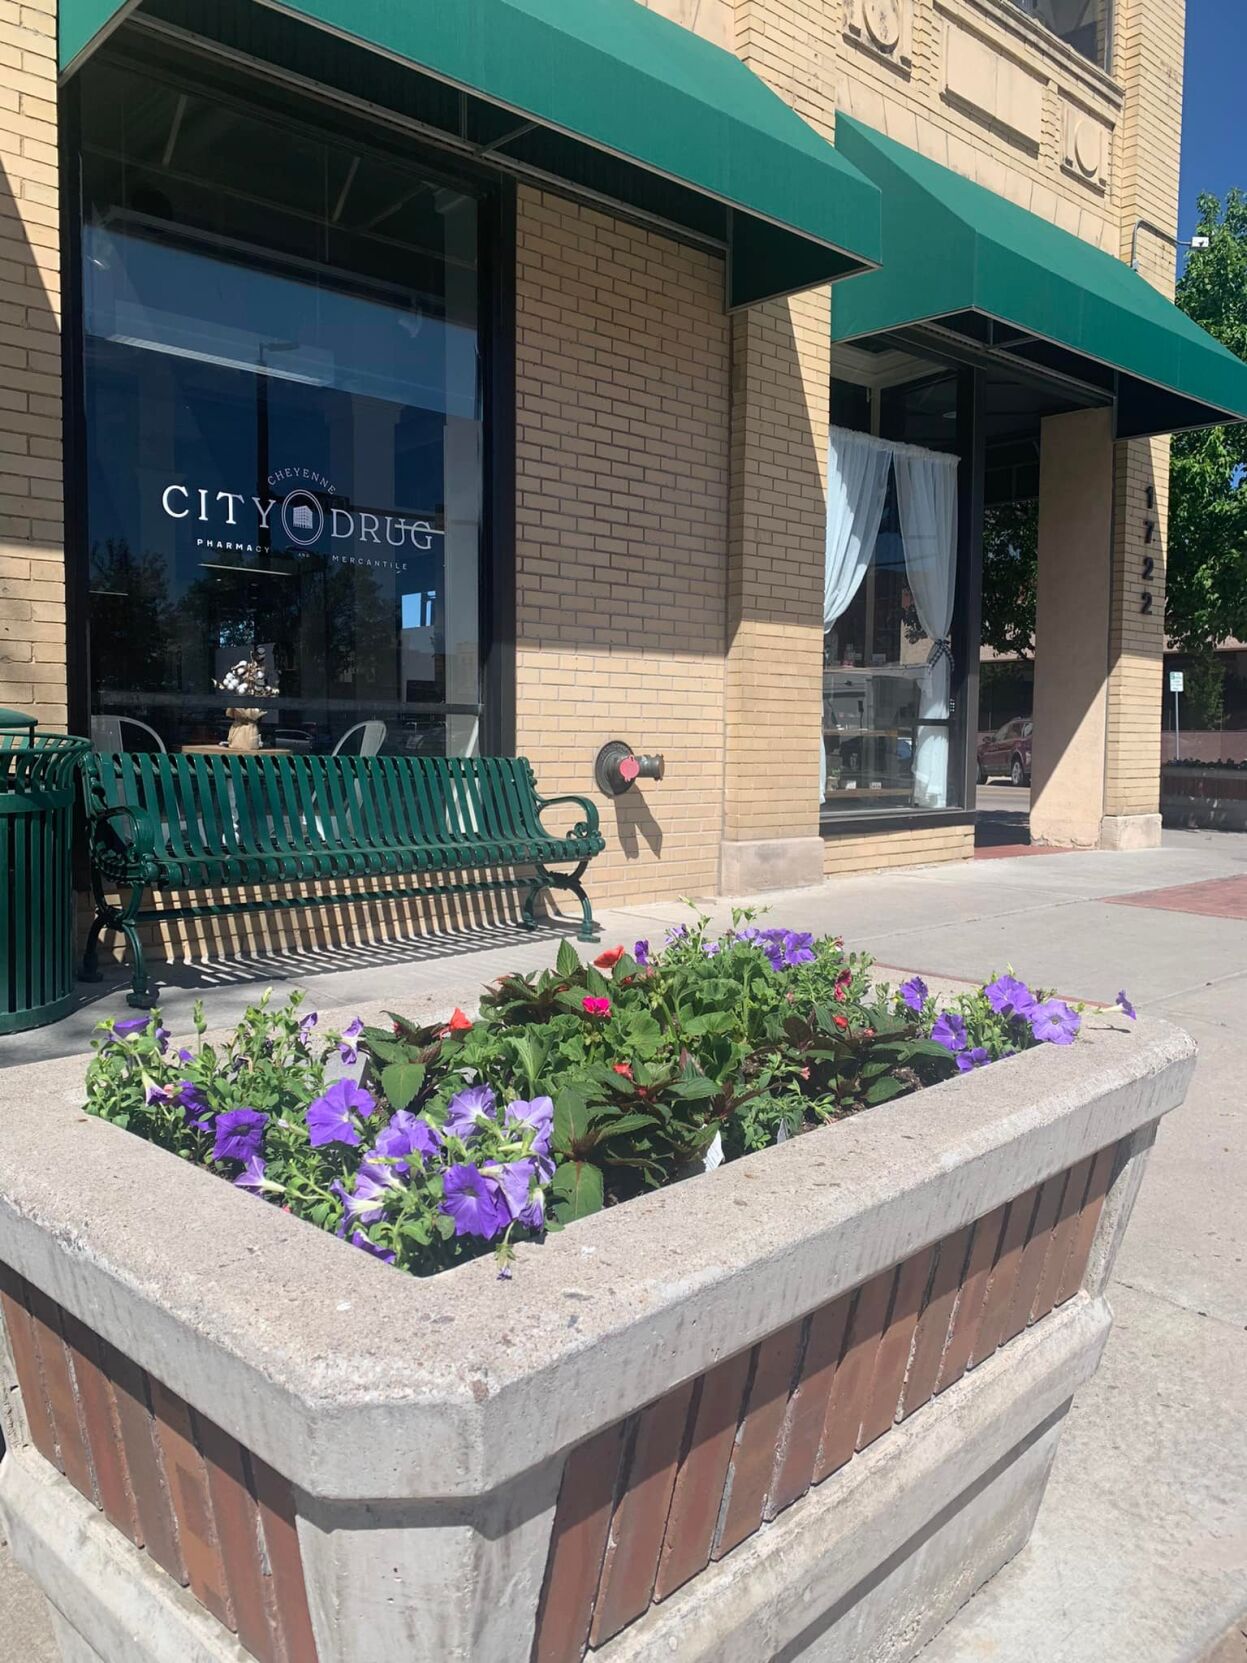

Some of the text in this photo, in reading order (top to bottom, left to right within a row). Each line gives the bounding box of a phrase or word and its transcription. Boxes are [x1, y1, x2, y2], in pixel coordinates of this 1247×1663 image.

[267, 467, 336, 496] CHEYENNE
[162, 485, 433, 550] CITY DRUG
[196, 538, 270, 553] PHARMACY
[332, 554, 409, 570] MERCANTILE
[1140, 485, 1155, 616] 1722
